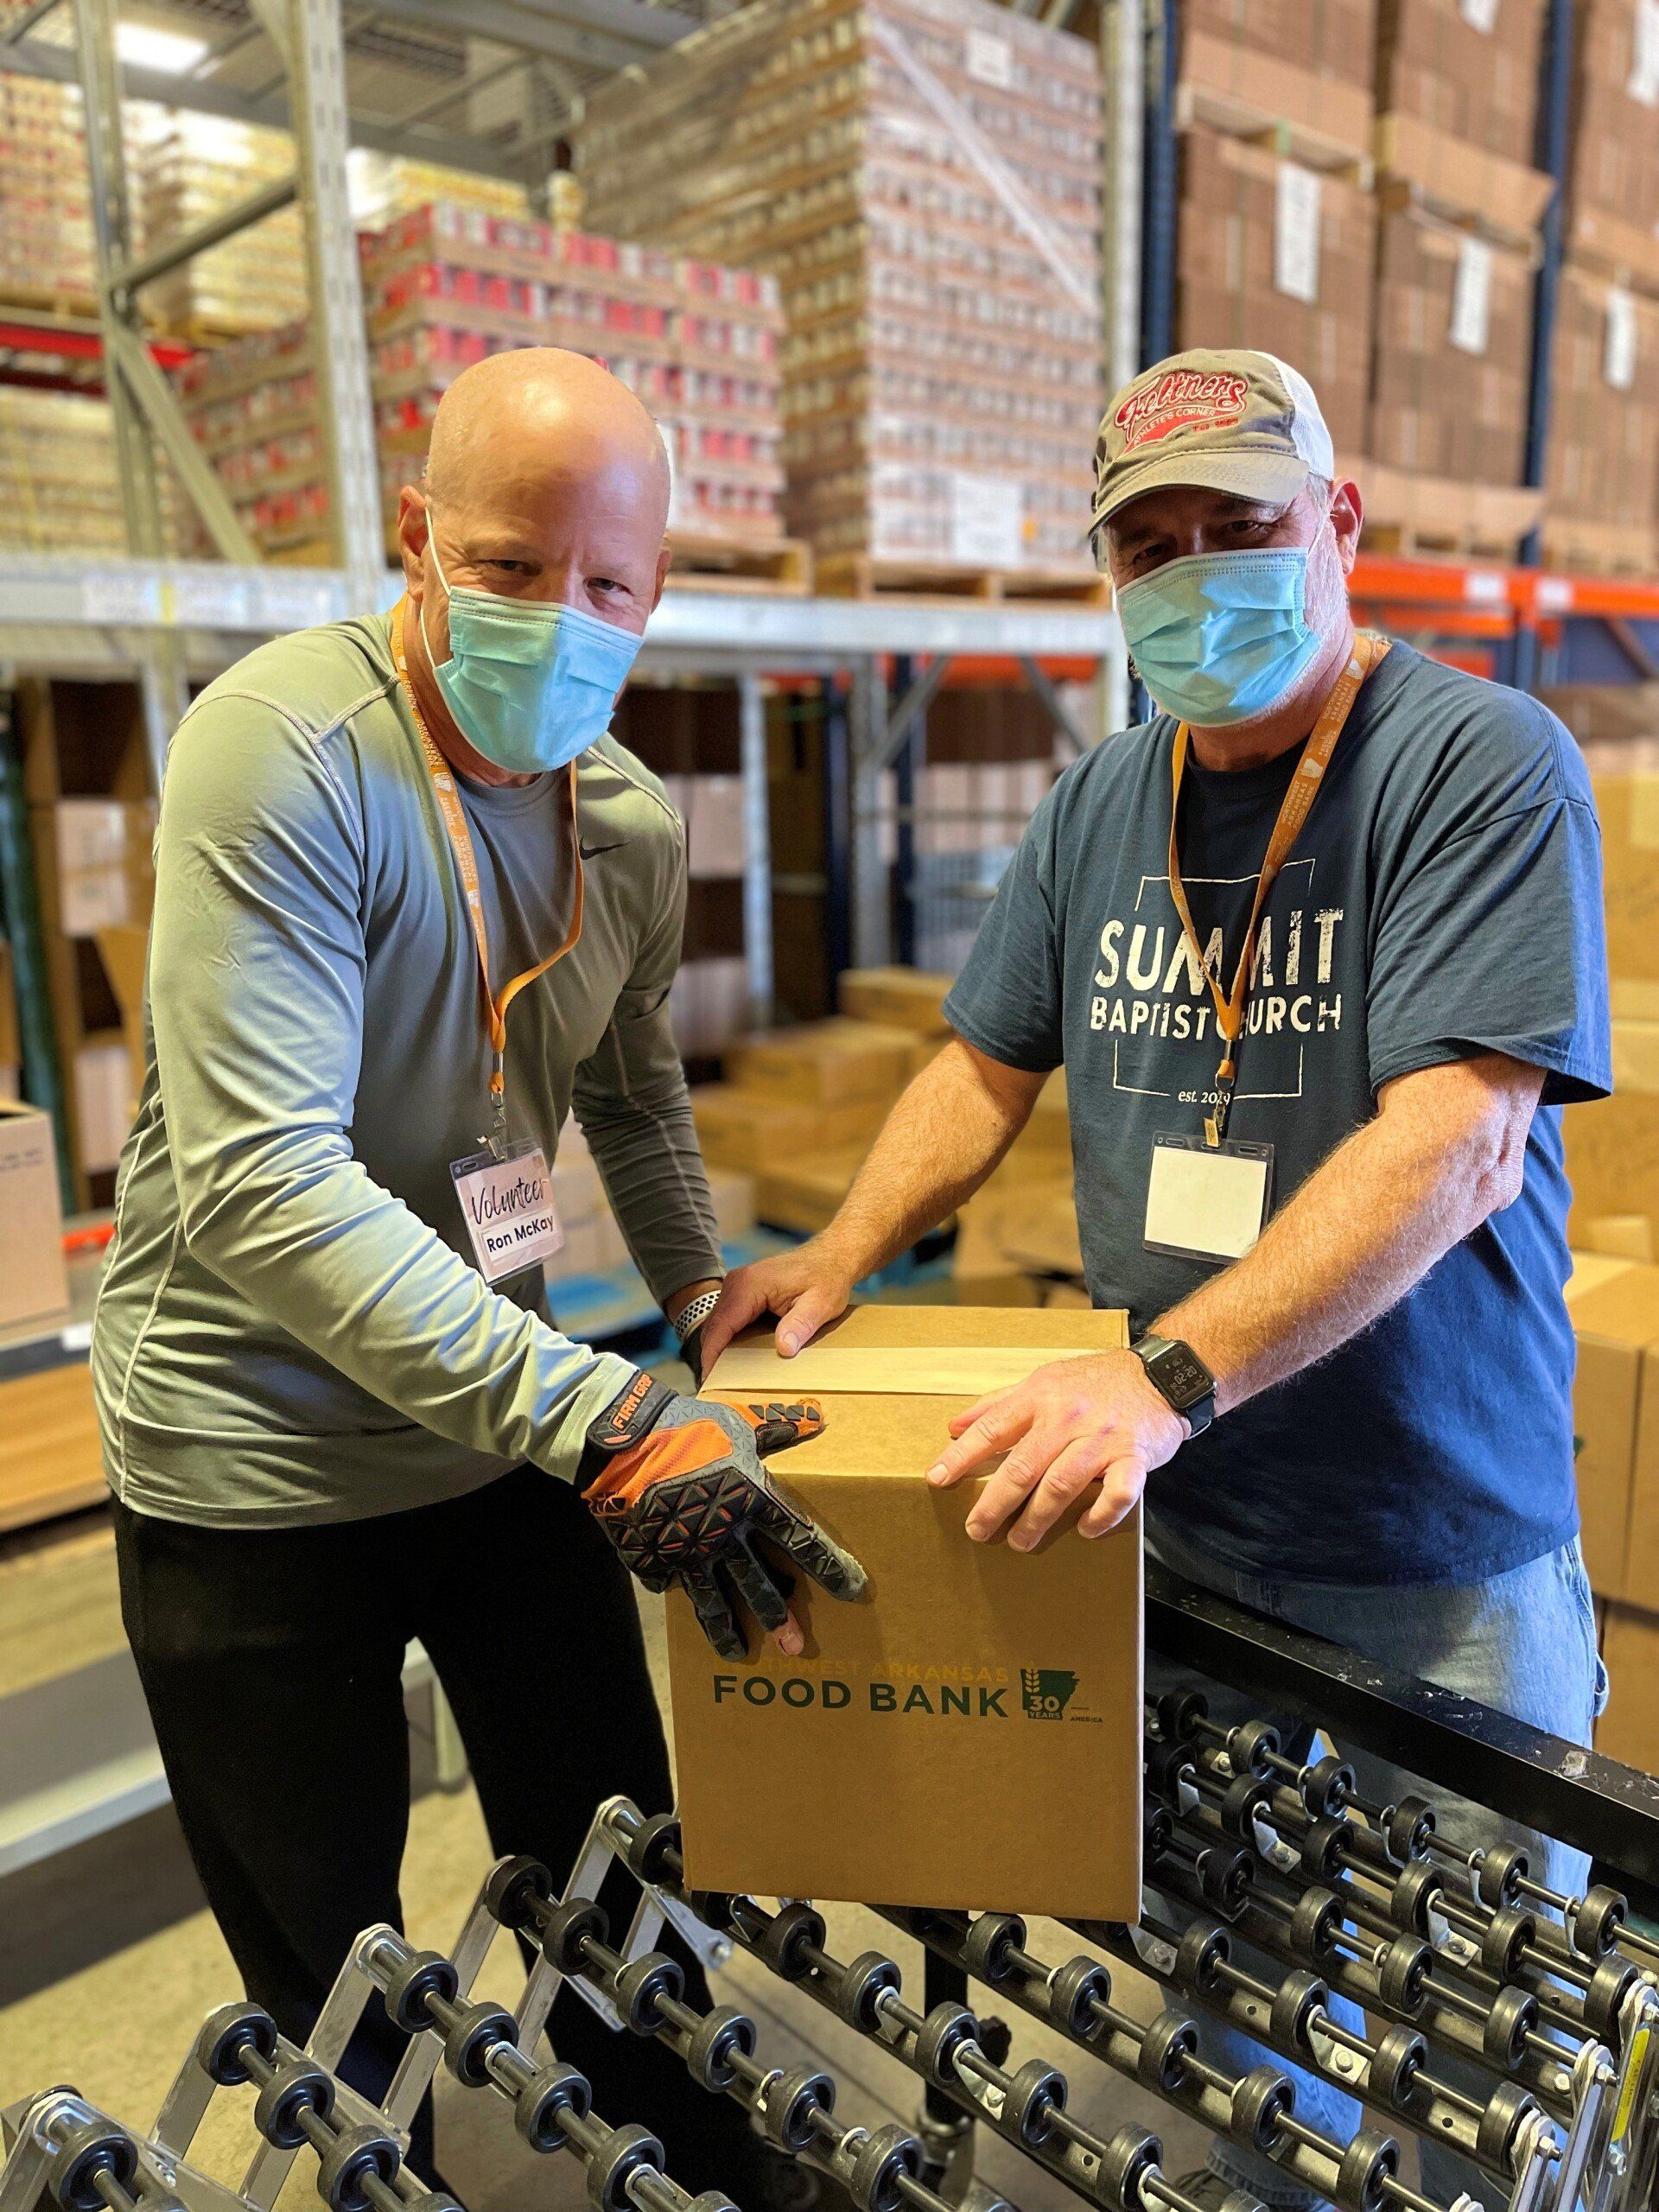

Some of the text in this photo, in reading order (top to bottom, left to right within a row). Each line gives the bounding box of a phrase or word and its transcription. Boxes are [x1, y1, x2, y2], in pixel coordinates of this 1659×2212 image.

[1176, 406, 1215, 418] CORNER
[1090, 996, 1211, 1040] BAPTIST
[1201, 1091, 1230, 1106] 209
[471, 1177, 546, 1225] Volunteer
[486, 1215, 554, 1253] Ron McKay
[613, 1394, 641, 1429] FIRM
[871, 1661, 1009, 1683] ARKANSAS
[714, 1675, 1009, 1718] FOOD BANK
[1029, 1695, 1060, 1712] 30
[1029, 1711, 1061, 1719] YEARS
